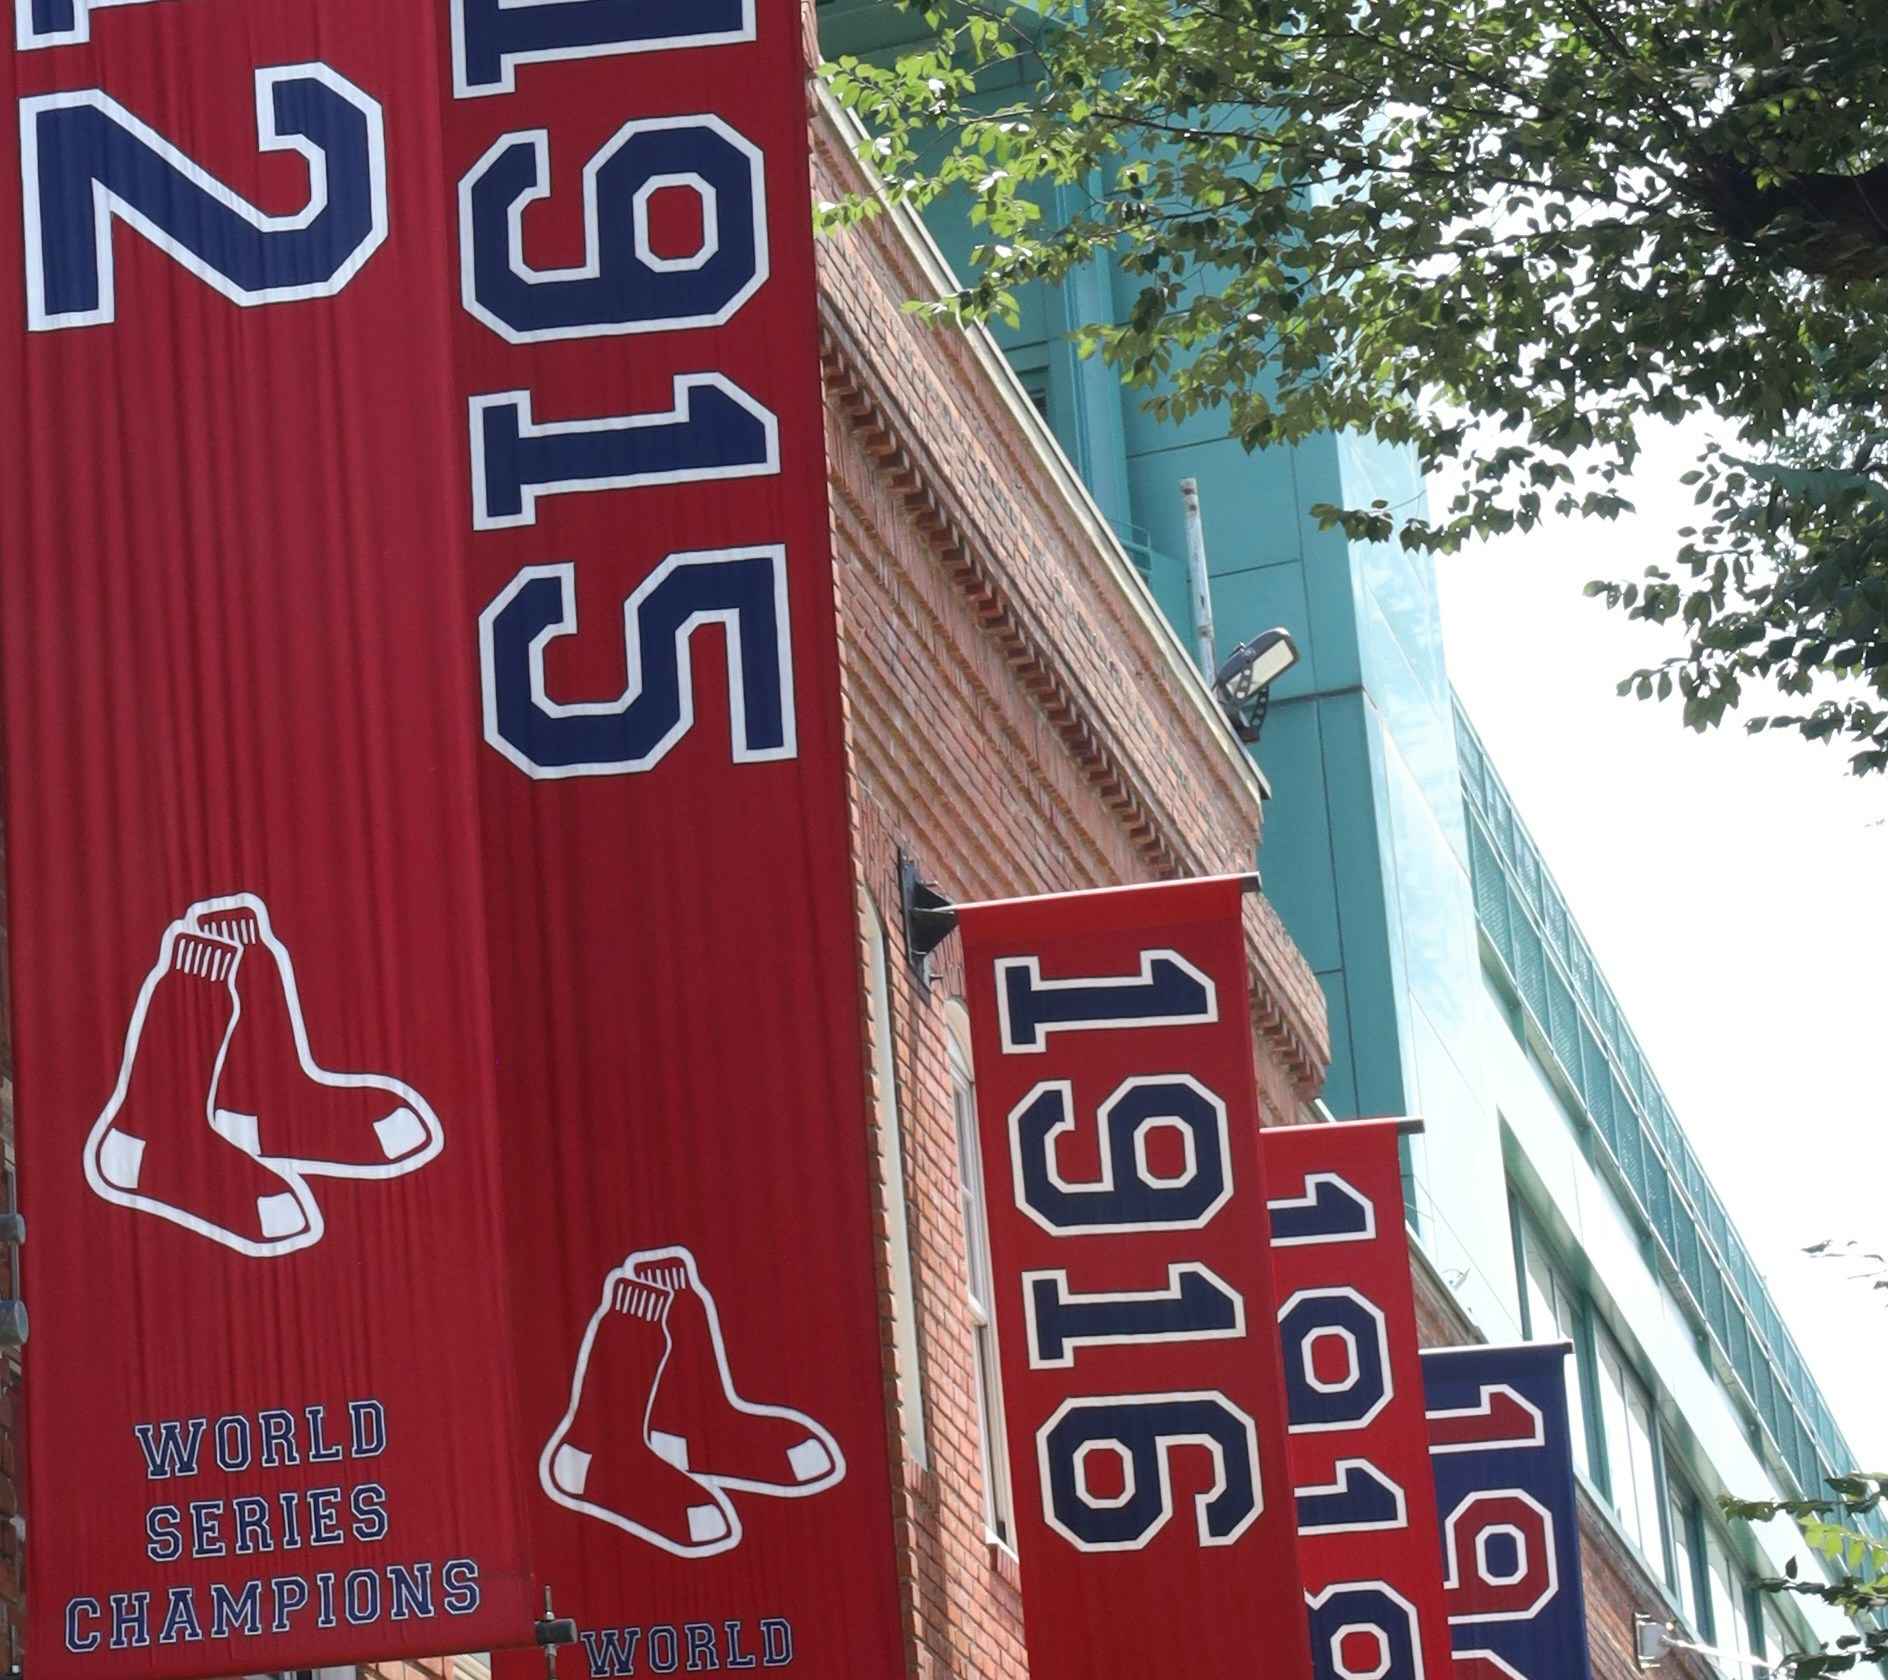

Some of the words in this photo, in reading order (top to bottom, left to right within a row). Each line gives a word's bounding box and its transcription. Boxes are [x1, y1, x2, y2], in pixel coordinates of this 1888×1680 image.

[994, 948, 1265, 1553] 1916
[133, 1397, 388, 1480] WORLD
[144, 1482, 389, 1563] SERIES
[63, 1557, 481, 1653] CHAMPIONS
[580, 1616, 794, 1679] WORLD
